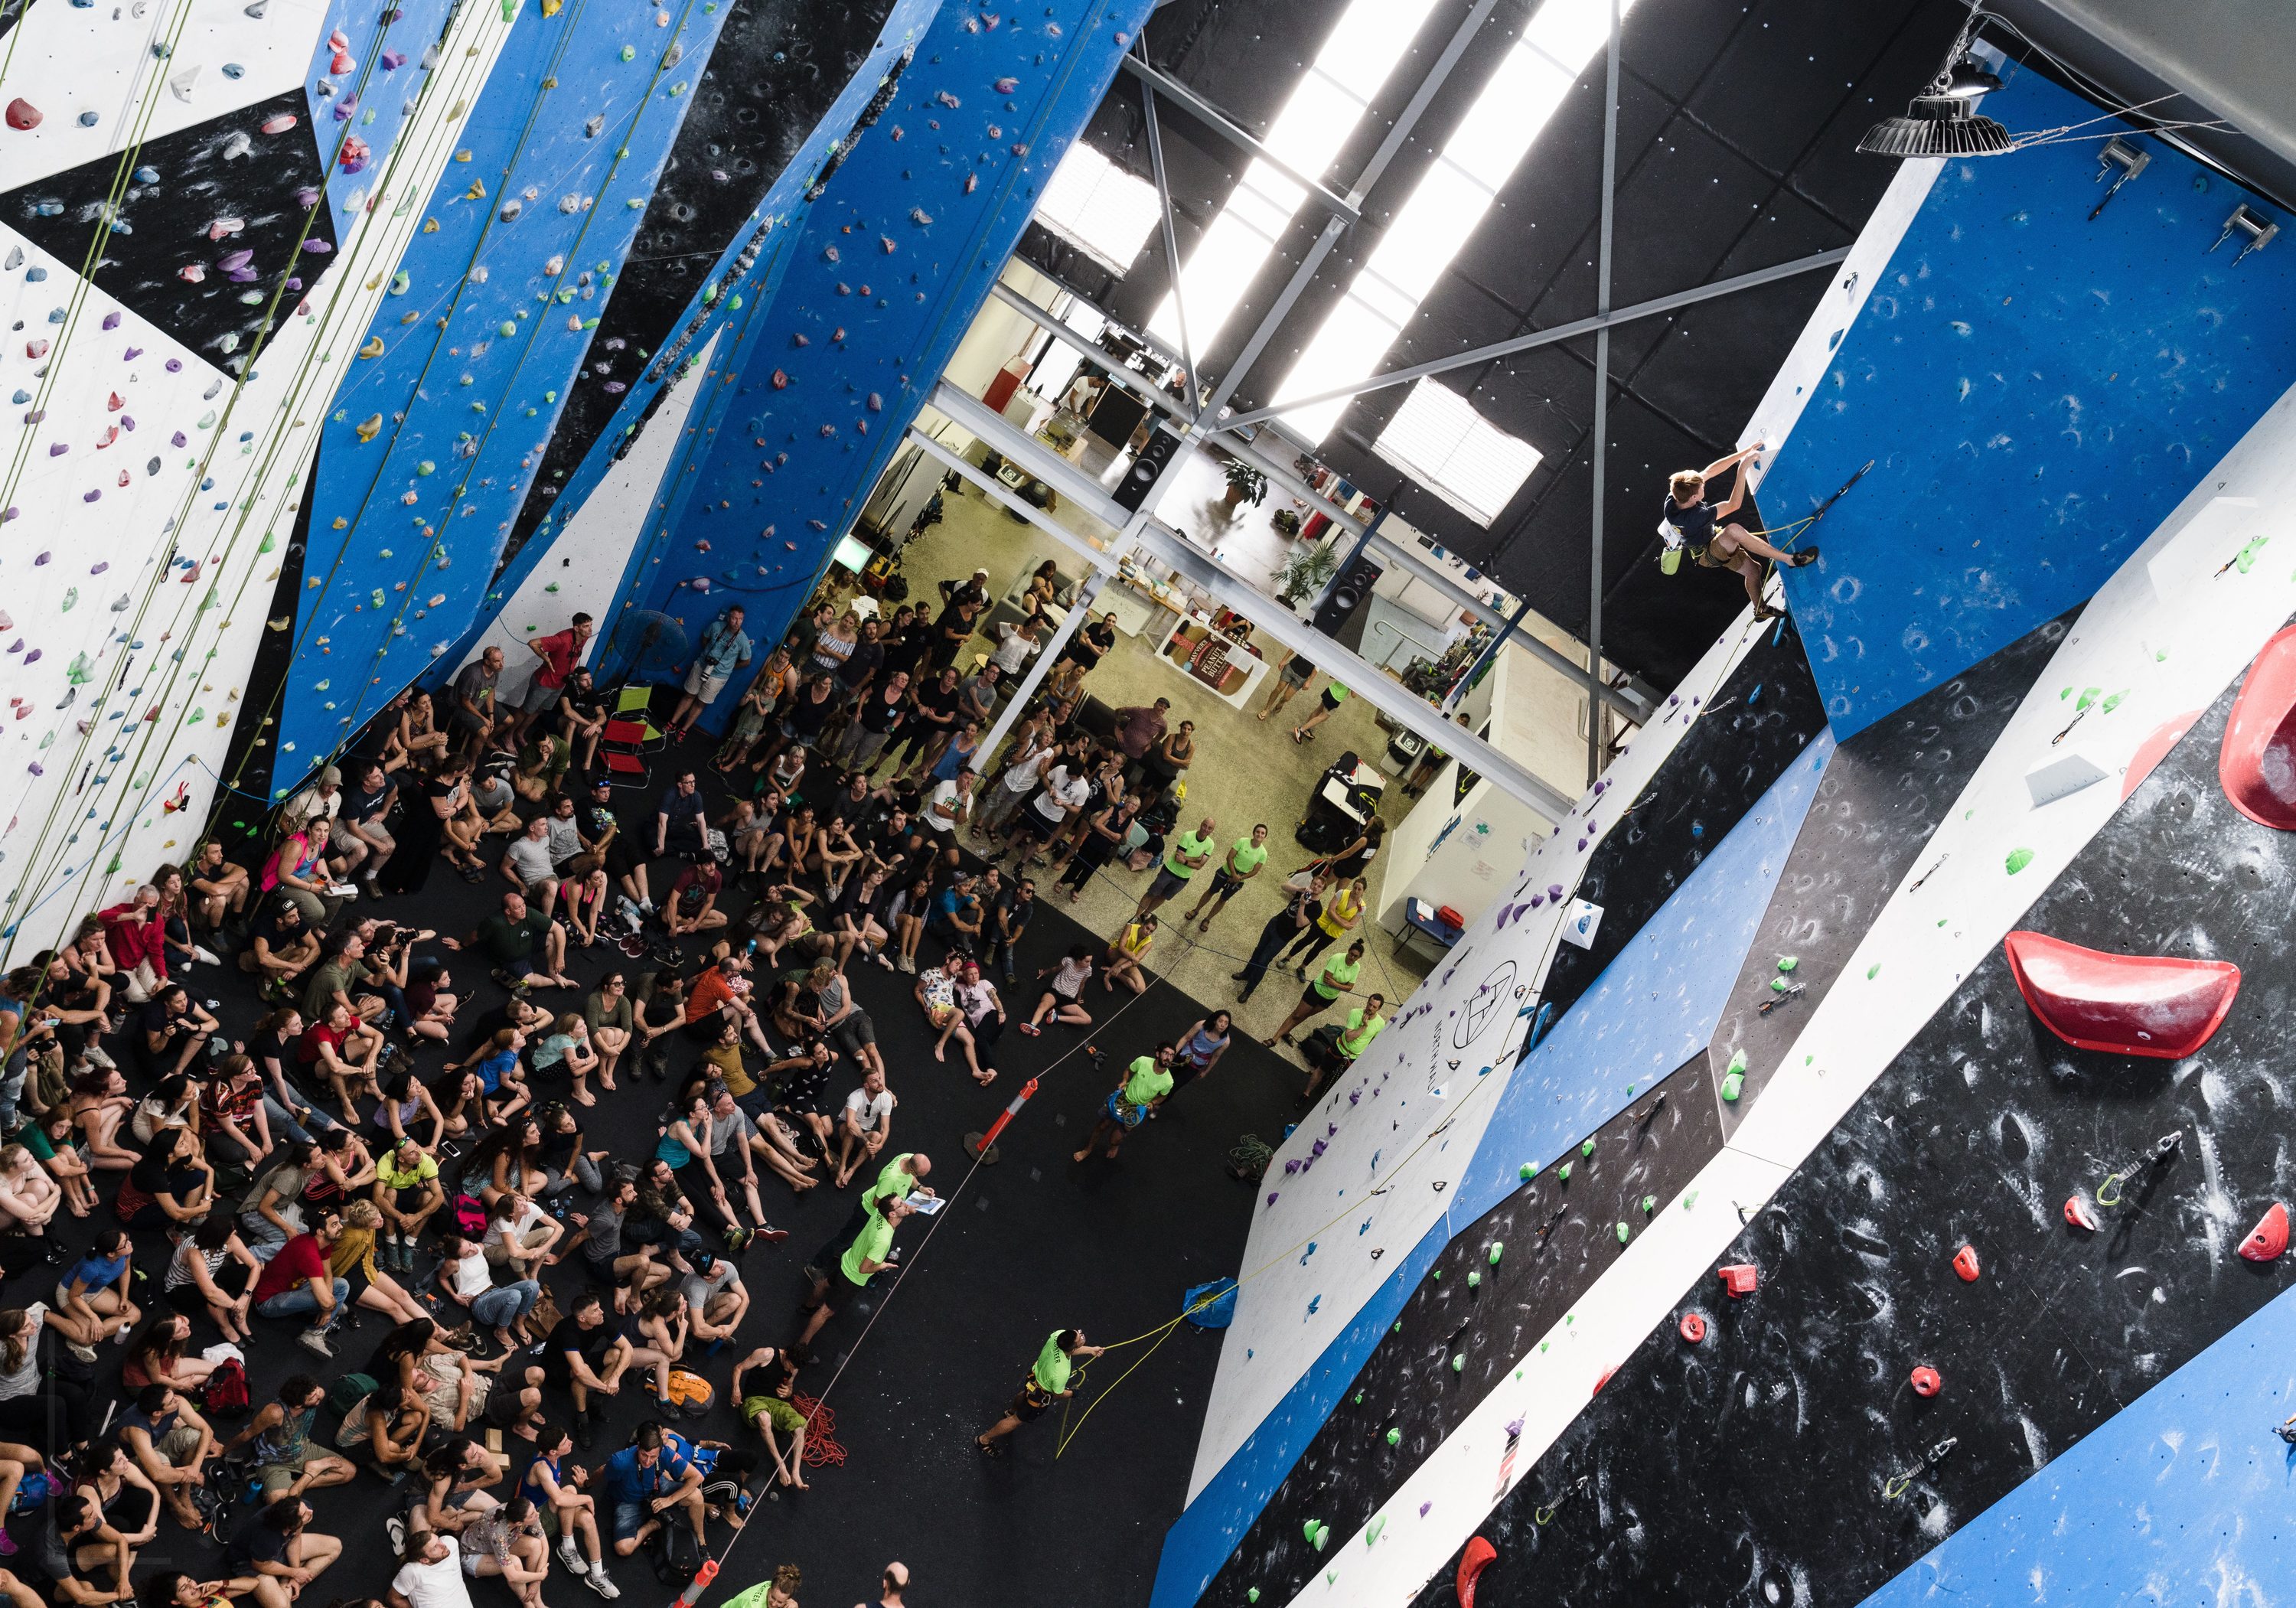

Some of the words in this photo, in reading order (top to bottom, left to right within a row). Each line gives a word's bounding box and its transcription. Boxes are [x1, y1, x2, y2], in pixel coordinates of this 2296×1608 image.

[1201, 646, 1223, 674] PEANUT
[1207, 651, 1228, 677] BUTTER
[1433, 1019, 1442, 1062] NORTH
